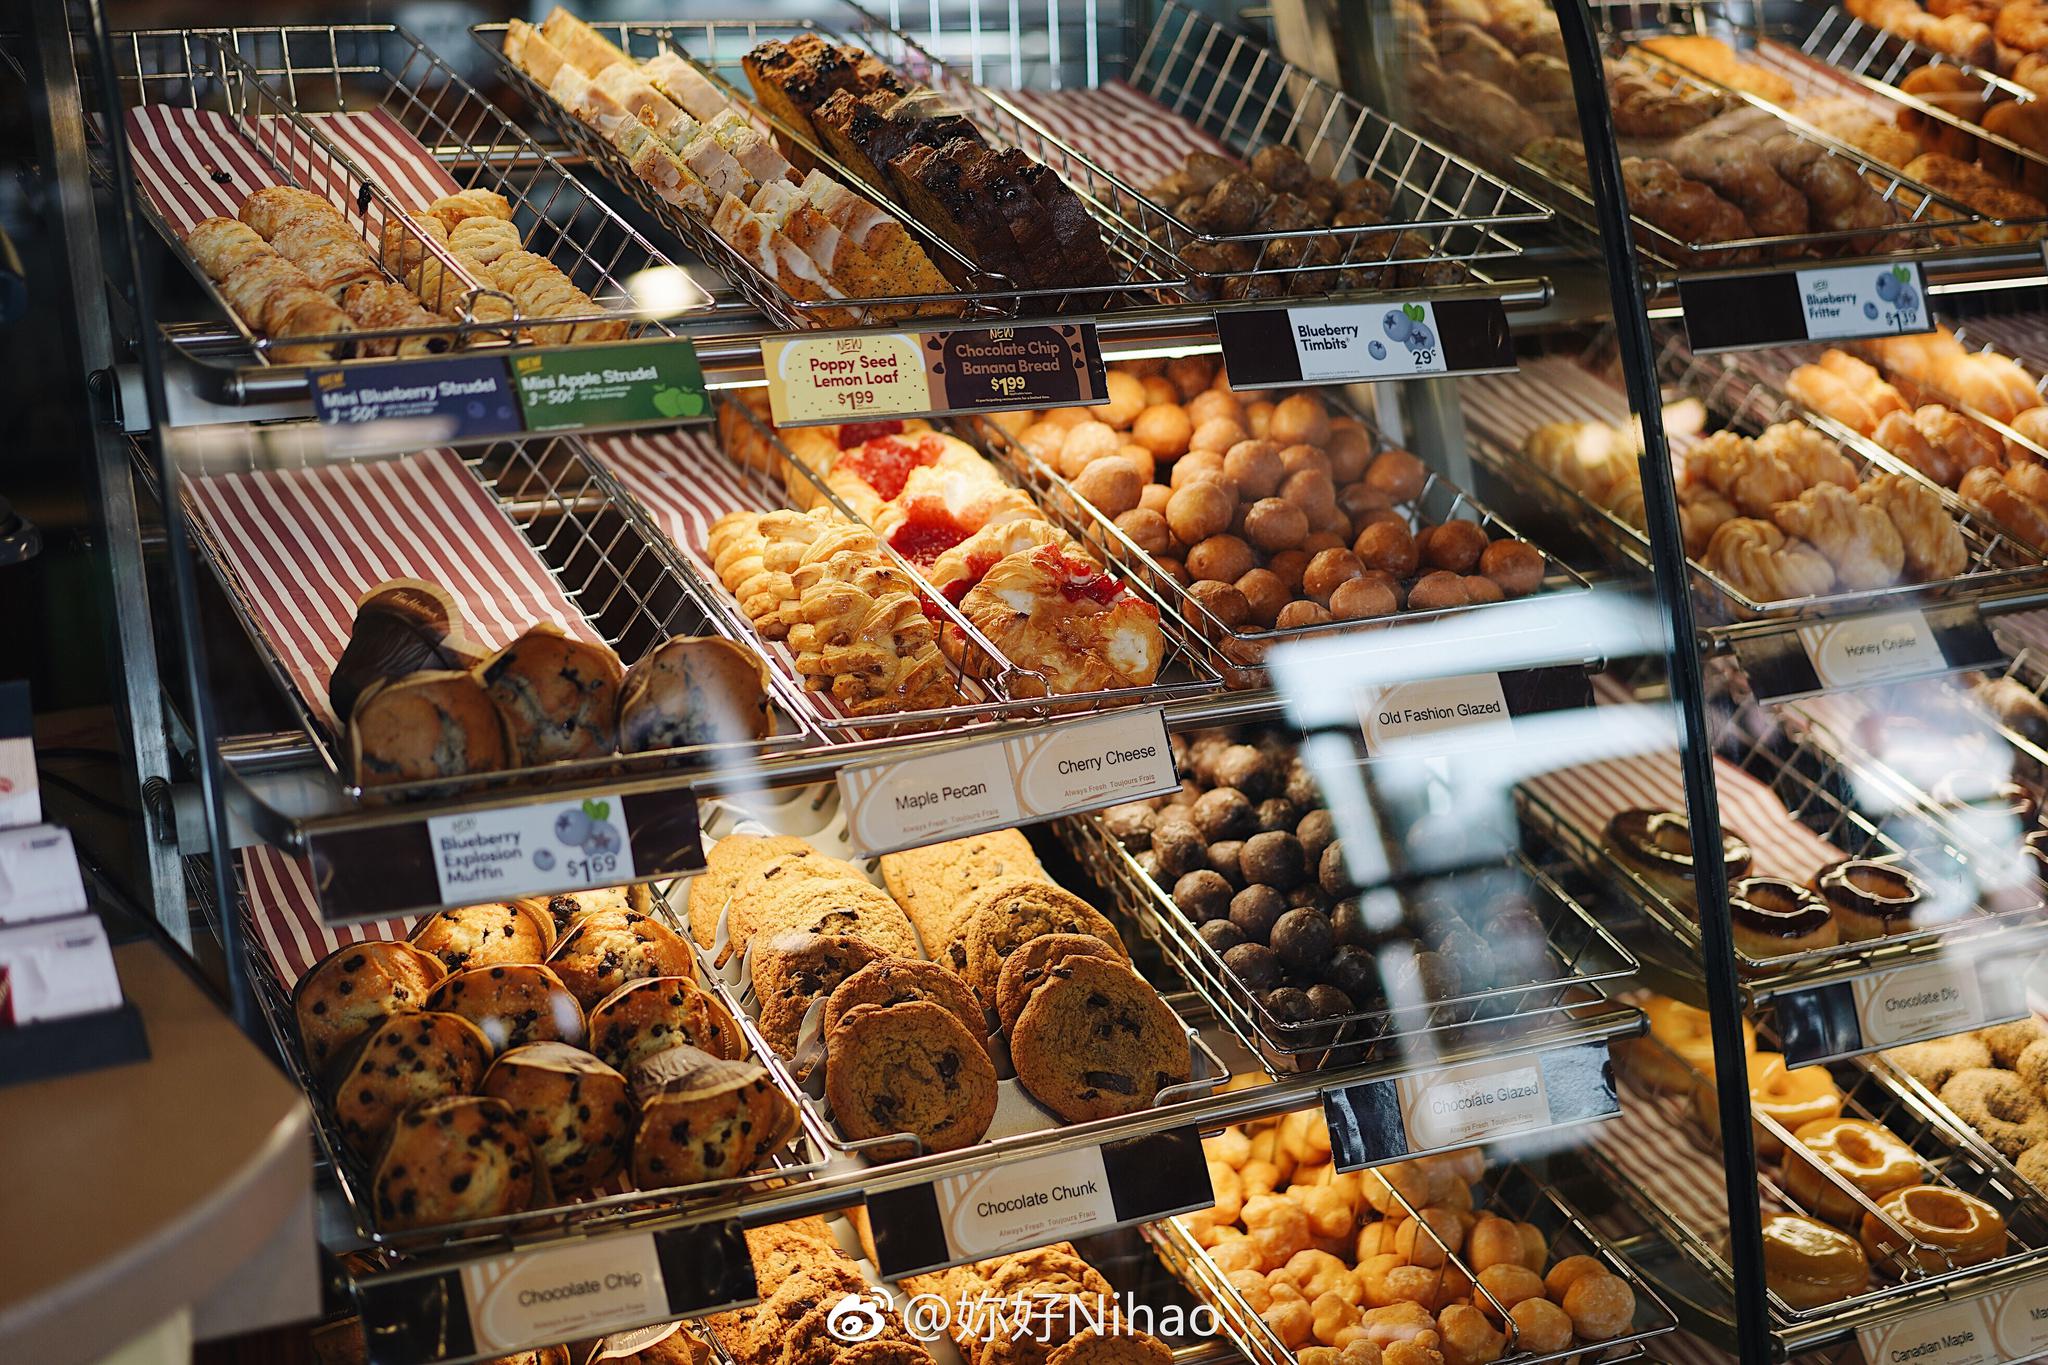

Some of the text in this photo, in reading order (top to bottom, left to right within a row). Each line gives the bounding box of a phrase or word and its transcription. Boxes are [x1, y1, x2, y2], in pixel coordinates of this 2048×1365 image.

[1806, 292, 1856, 305] Blueberry
[1809, 307, 1840, 319] Fritter
[990, 328, 1014, 340] NEW
[1298, 324, 1359, 338] Blueberry
[837, 338, 862, 351] NEW
[955, 341, 1060, 357] Chocolate Chip
[810, 354, 897, 374] Poppy Seed
[962, 358, 1061, 375] Banana Bread
[1413, 349, 1436, 365] 29¢
[521, 366, 658, 391] Mini Apple Strudel
[814, 370, 899, 388] Lemon Loaf
[991, 376, 1026, 396] $199
[322, 377, 497, 408] Mini Blueberry Strudel
[838, 391, 874, 410] $199
[1379, 700, 1501, 725] Old Fashion Glazed
[1058, 746, 1156, 775] Cherry Cheese
[896, 781, 987, 810] Maple Pecan
[1065, 774, 1155, 797] Always Fresh Toujours Frais
[441, 831, 521, 850] Blueberry
[443, 848, 523, 868] Explosion
[448, 867, 504, 883] Muffin
[567, 854, 616, 883] $169
[1885, 992, 1940, 1012] Chocolate
[1432, 1081, 1539, 1115] Chocolate Glazed
[977, 1180, 1098, 1218] Chocolate Chunk
[1000, 1226, 1024, 1237] Always
[1024, 1222, 1045, 1231] Fresh
[518, 1271, 643, 1307] Chocolate Chip
[1891, 1341, 1942, 1363] Canadian
[1941, 1330, 1975, 1351] Maple
